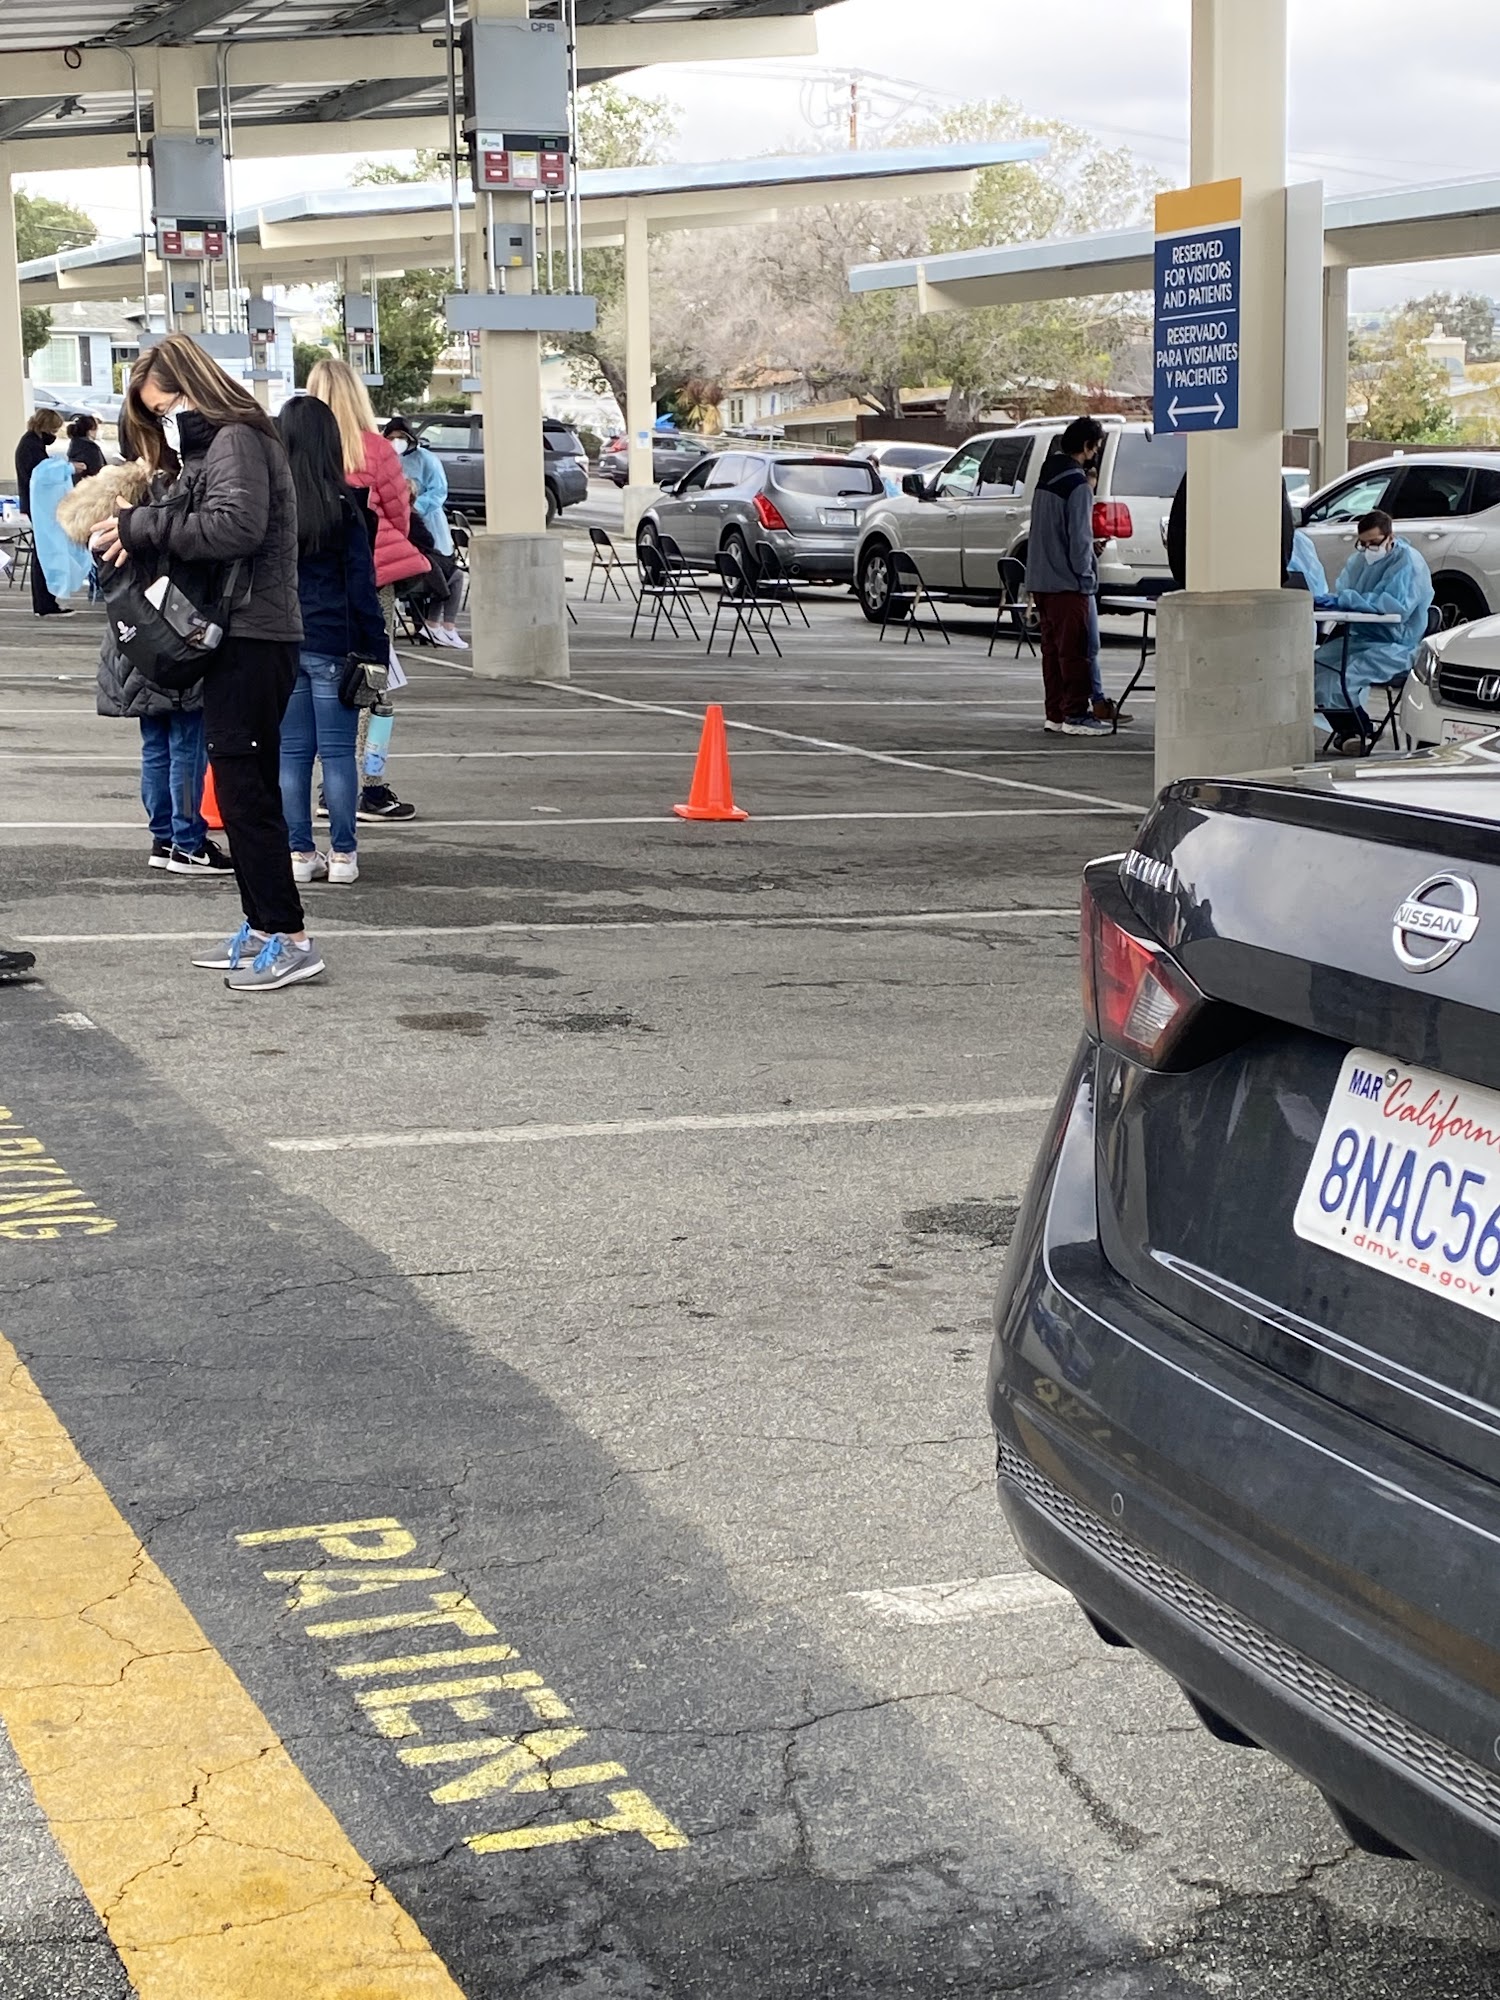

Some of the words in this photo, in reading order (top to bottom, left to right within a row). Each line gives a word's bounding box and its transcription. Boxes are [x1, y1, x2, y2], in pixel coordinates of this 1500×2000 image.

[531, 22, 555, 32] CPS
[1172, 240, 1223, 265] RESERVED
[1164, 267, 1185, 288] FOR
[1186, 261, 1232, 284] VISITORS
[1163, 289, 1187, 309] AND
[1188, 283, 1232, 306] PATIENTS
[1167, 321, 1227, 345] RESERVADO
[1156, 349, 1183, 368] PARA
[1184, 343, 1238, 365] VISITANTES
[1166, 373, 1174, 388] Y
[1174, 366, 1228, 387] PACIENTES
[1396, 906, 1463, 934] NISSAN
[1349, 1068, 1384, 1102] MAR
[1383, 1078, 1500, 1153] Californ
[1319, 1128, 1500, 1276] 8NAC56
[1353, 1233, 1482, 1295] dmv.ca.gov
[235, 1516, 691, 1855] PATIENT
